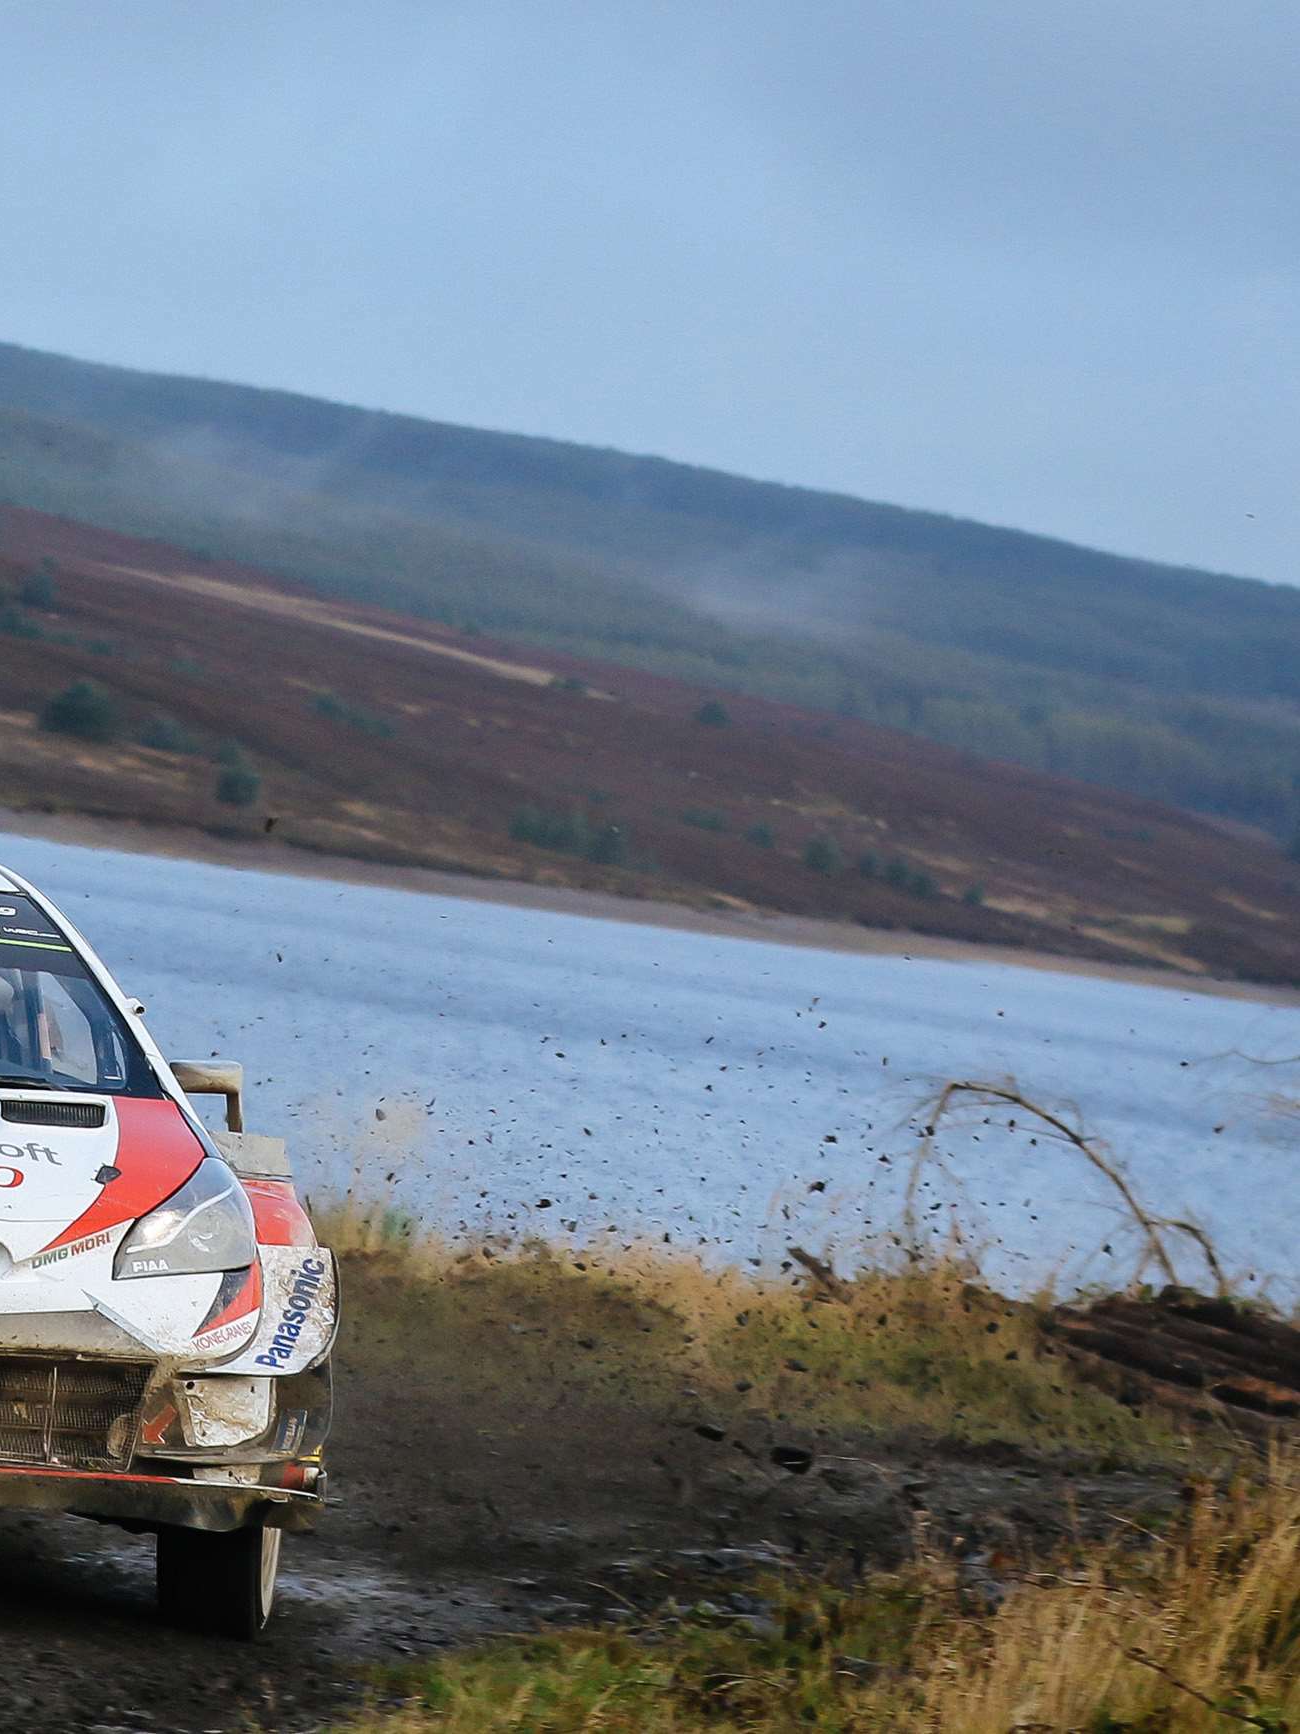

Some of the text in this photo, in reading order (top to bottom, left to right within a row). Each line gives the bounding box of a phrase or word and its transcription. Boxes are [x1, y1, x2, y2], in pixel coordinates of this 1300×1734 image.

[32, 1231, 111, 1269] DMG MORI
[132, 1259, 170, 1273] PIAA
[254, 1258, 325, 1370] Panasonic
